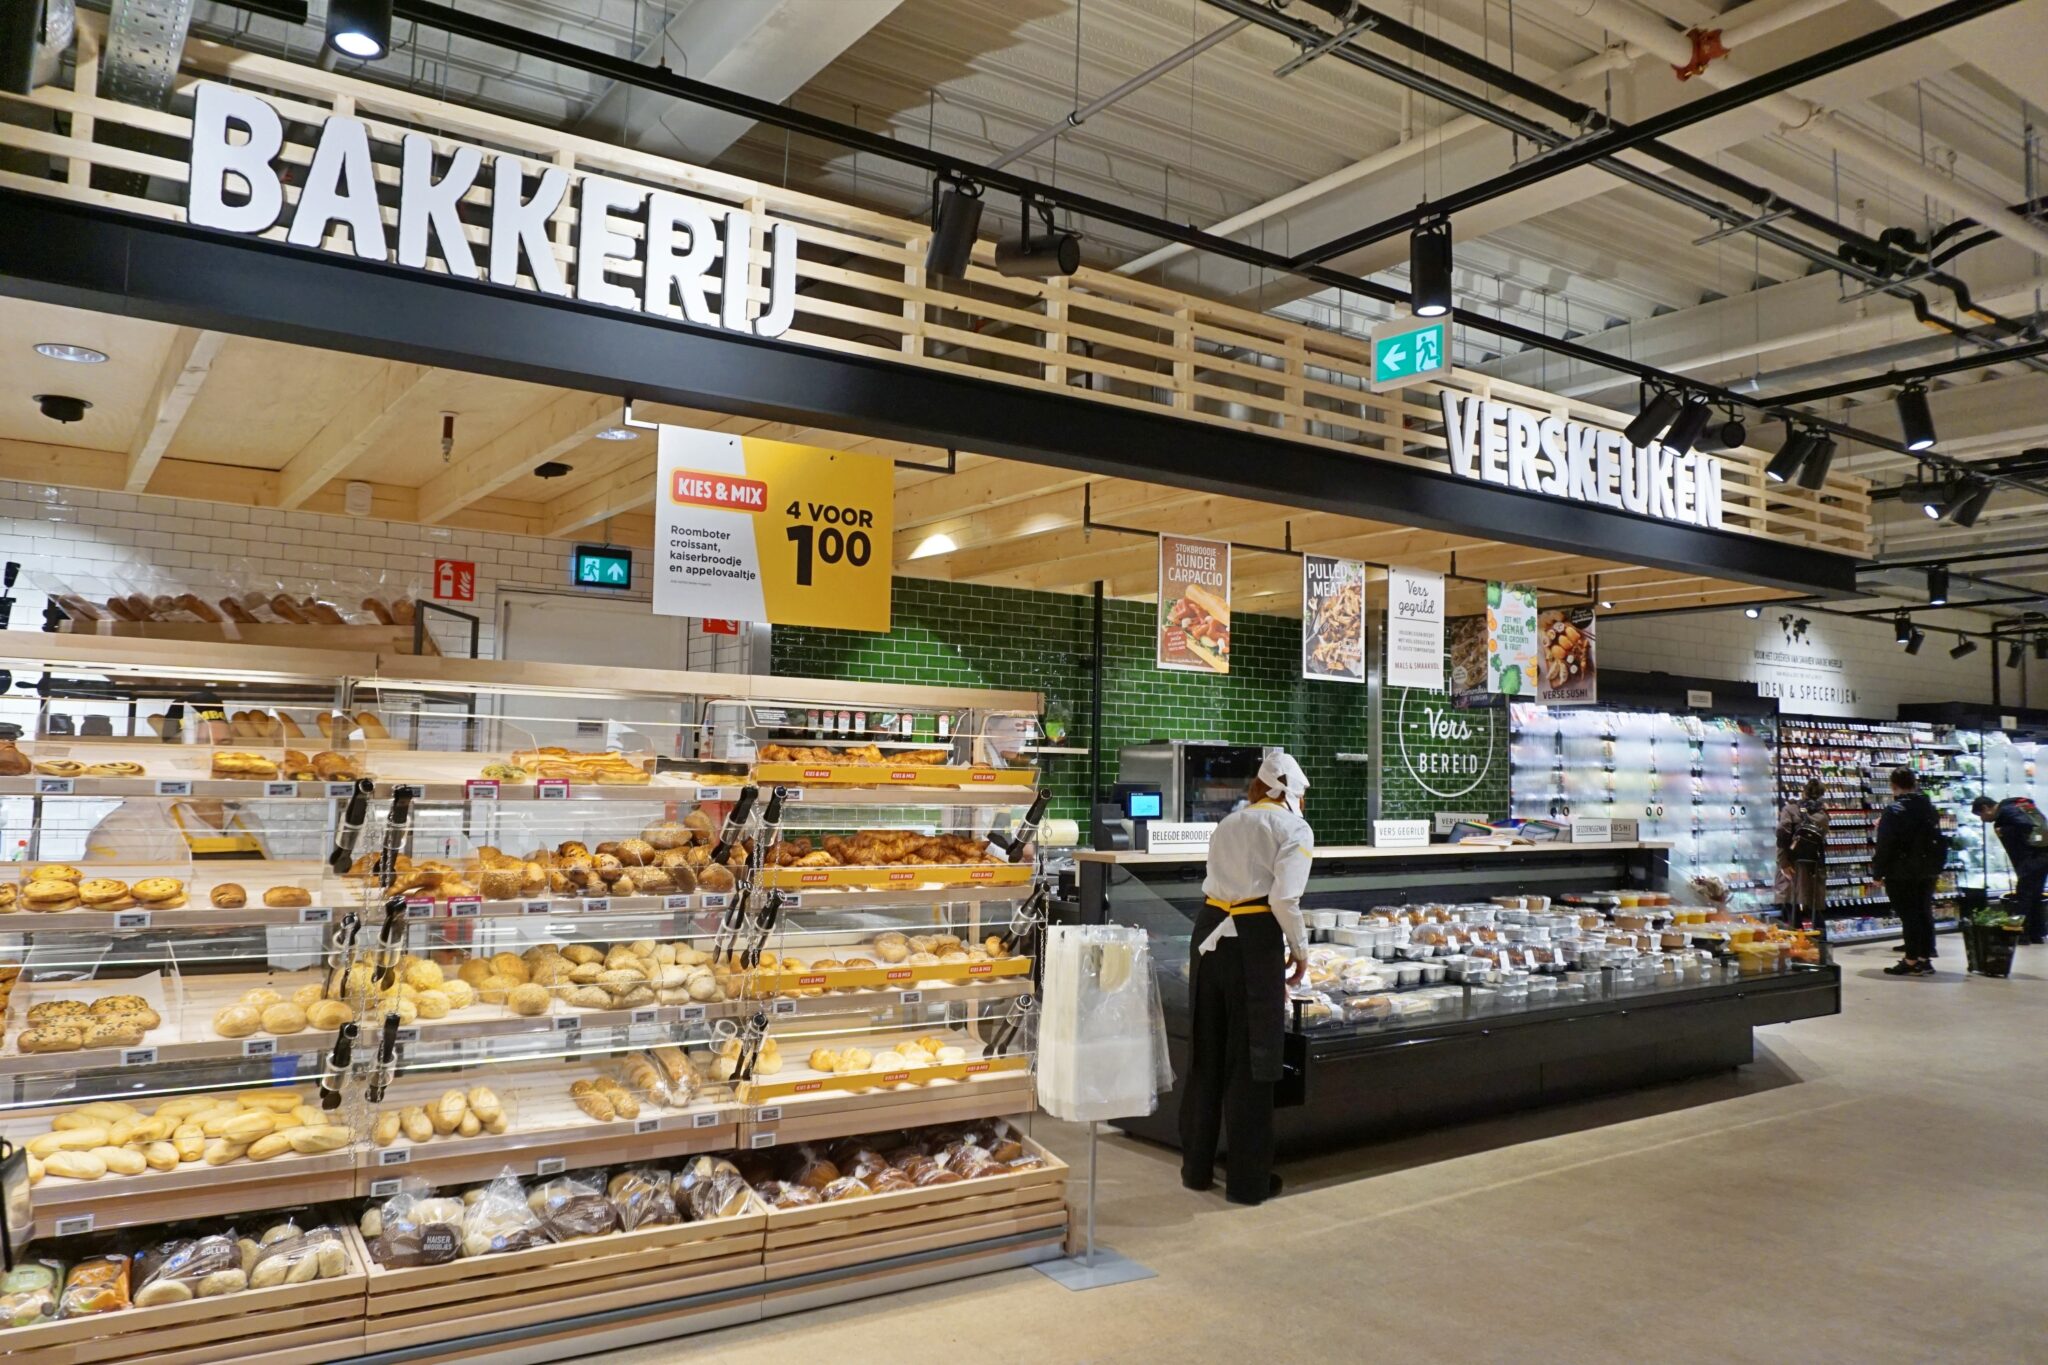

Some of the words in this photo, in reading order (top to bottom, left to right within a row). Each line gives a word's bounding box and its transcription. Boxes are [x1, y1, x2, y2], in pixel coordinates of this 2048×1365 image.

[188, 82, 798, 339] BAKKERIJ
[1440, 390, 1722, 529] VERSKEUKEN
[678, 477, 712, 498] KIES
[715, 482, 728, 500] &
[730, 485, 763, 505] MIX
[786, 501, 801, 519] 4
[808, 502, 873, 528] VOOR
[671, 525, 731, 540] Roomboter
[670, 539, 721, 553] croissant,
[669, 551, 742, 567] kaiserbroodje
[1175, 553, 1216, 571] RUNDER
[669, 564, 683, 573] en
[685, 566, 756, 581] appelovaaltje
[1168, 567, 1223, 586] CARPACCIO
[1308, 563, 1347, 580] PULLED
[1313, 581, 1341, 598] MEAT
[1405, 579, 1429, 597] Vers
[1398, 600, 1435, 617] gegrild
[1542, 689, 1565, 700] VERSE
[1566, 688, 1588, 698] SUSHI
[1760, 682, 1784, 698] IDEN
[1790, 685, 1795, 698] &
[1424, 707, 1472, 740] Vers
[1419, 752, 1478, 774] BEREID
[1152, 831, 1180, 841] BELEGDE
[1378, 826, 1396, 837] VERS
[1398, 826, 1425, 836] GEGRILD
[1611, 824, 1631, 832] USHI
[427, 1236, 451, 1244] KAISER
